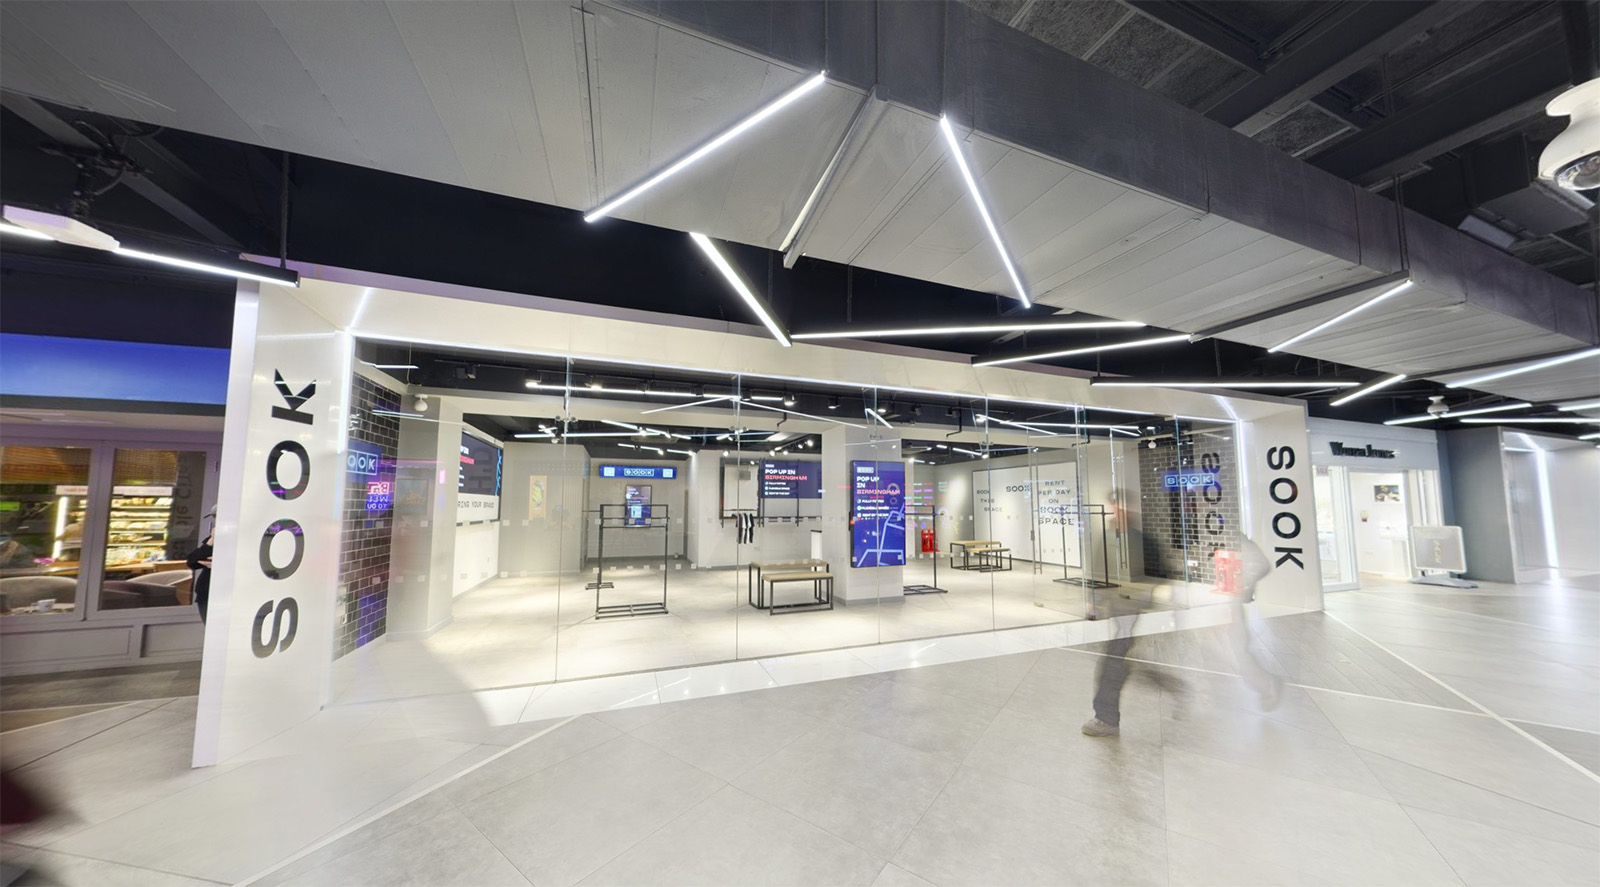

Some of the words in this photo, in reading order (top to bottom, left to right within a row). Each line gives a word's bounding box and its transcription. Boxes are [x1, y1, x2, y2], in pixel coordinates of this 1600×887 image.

[347, 454, 376, 471] OOK
[1166, 475, 1212, 485] SOOK
[251, 368, 317, 659] SOOK
[1266, 445, 1305, 571] SOOK
[1038, 517, 1074, 525] SPACE
